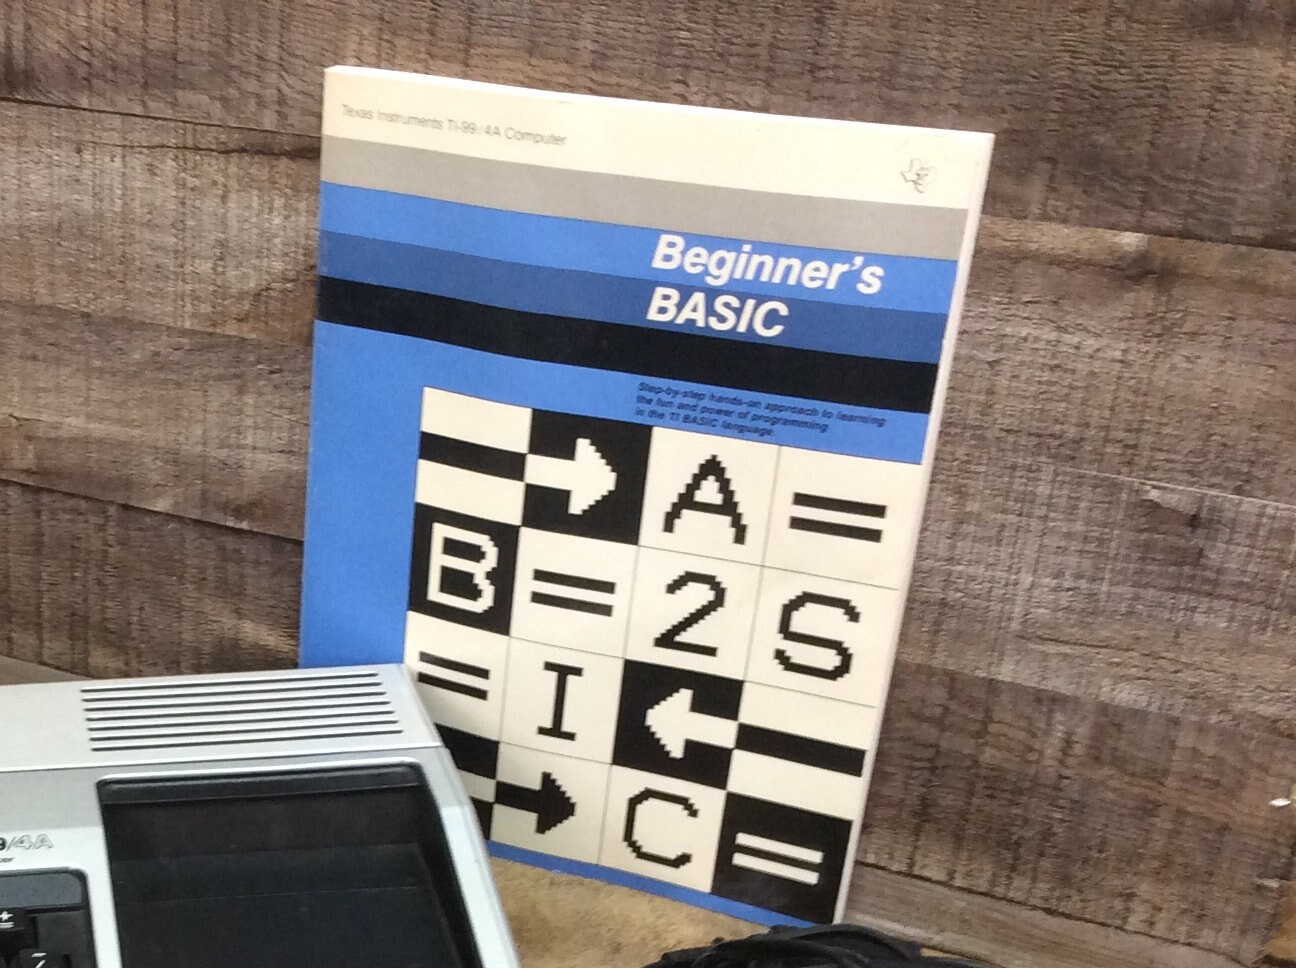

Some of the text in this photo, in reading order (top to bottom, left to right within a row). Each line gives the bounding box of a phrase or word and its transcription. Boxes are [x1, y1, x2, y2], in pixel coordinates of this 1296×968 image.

[342, 104, 373, 120] Texas
[377, 109, 443, 130] Instruments
[504, 127, 567, 145] Computer
[651, 233, 885, 295] Beginner's
[646, 286, 790, 338] BASIC
[677, 401, 698, 412] and
[700, 405, 735, 419] power
[821, 408, 833, 419] to
[836, 411, 887, 428] learning
[663, 454, 747, 546] A
[427, 521, 500, 614] B
[653, 570, 728, 657] 2
[773, 591, 862, 682] S
[536, 660, 585, 743] I
[623, 786, 700, 870] C
